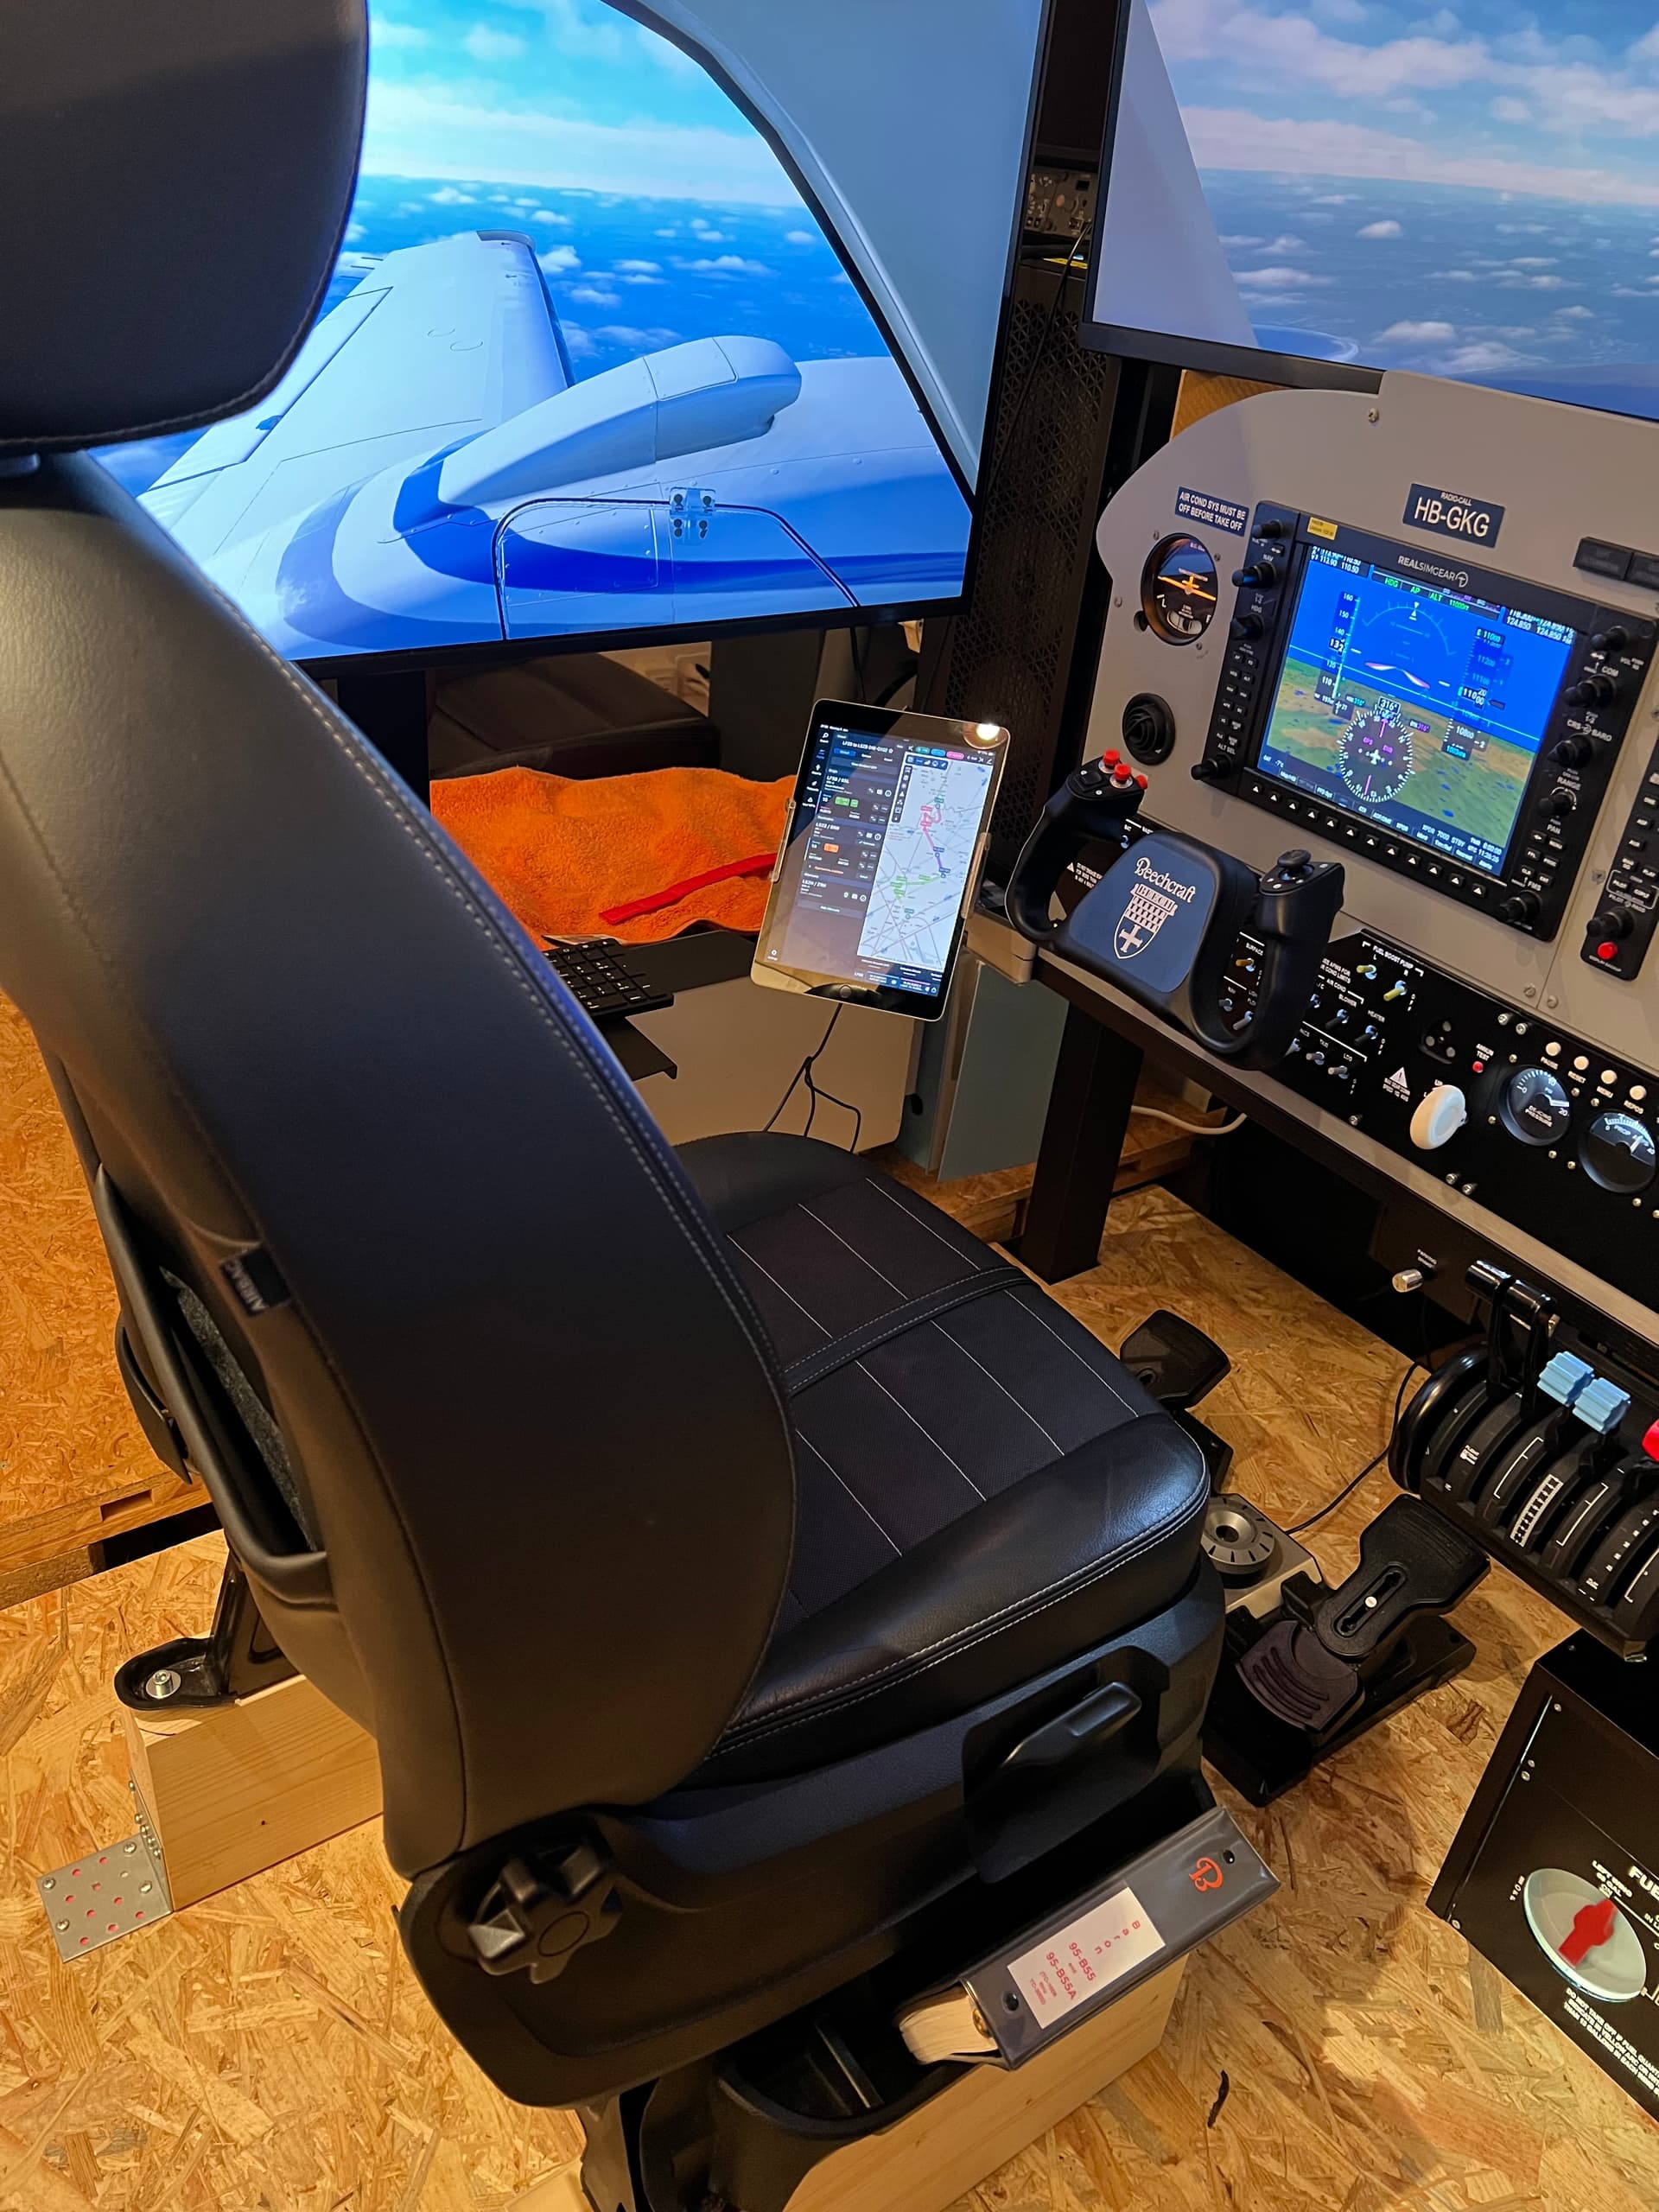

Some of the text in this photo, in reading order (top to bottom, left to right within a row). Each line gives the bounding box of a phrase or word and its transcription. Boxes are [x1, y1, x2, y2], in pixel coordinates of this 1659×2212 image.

[1179, 491, 1247, 520] AIR COND SYS MUST BE
[1178, 502, 1243, 531] OFF BEFORE TAKE OFF
[1414, 496, 1491, 537] HB-GKG
[1397, 555, 1456, 582] REALSIMGEAR
[1384, 576, 1400, 589] HDG
[1343, 594, 1354, 602] 160
[1429, 593, 1443, 602] ALT
[1338, 610, 1350, 620] 150
[1601, 666, 1619, 677] COM
[1322, 676, 1333, 687] 110
[1380, 699, 1398, 711] 316°
[1592, 729, 1612, 742] BARO
[1217, 742, 1236, 756] ALT SEL
[1557, 777, 1581, 791] RANGE
[1547, 824, 1561, 835] PAN
[1643, 868, 1656, 877] PLAY
[1135, 857, 1196, 903] Beechcraft
[1138, 887, 1173, 912] BEECH
[1372, 945, 1414, 969] FUEL BOOST PUMP
[1333, 982, 1347, 993] COND
[1338, 994, 1357, 1007] BLOWER
[1368, 1009, 1385, 1023] HEATER
[1477, 1050, 1490, 1061] TEST
[1558, 1108, 1568, 1116] 20
[1605, 1880, 1623, 1897] GAL
[1610, 1874, 1633, 1897] WING
[1069, 1942, 1096, 1981] 95-B55
[1046, 1952, 1077, 2000] 95-B55A
[1566, 1987, 1577, 1999] DO
[1575, 1996, 1590, 2011] NOT
[1587, 2005, 1605, 2026] TAKE
[1603, 2022, 1617, 2037] OFF
[1615, 2033, 1624, 2042] IF
[1622, 2037, 1639, 2057] FUEL
[1567, 1998, 1649, 2075] INDICATE IN YELLOW ARC OR
[1563, 2001, 1581, 2021] THAN
[1586, 2025, 1615, 2054] GALLONS
[1612, 2050, 1622, 2060] IN
[1619, 2056, 1640, 2076] EACH
[1637, 2071, 1656, 2090] WING
